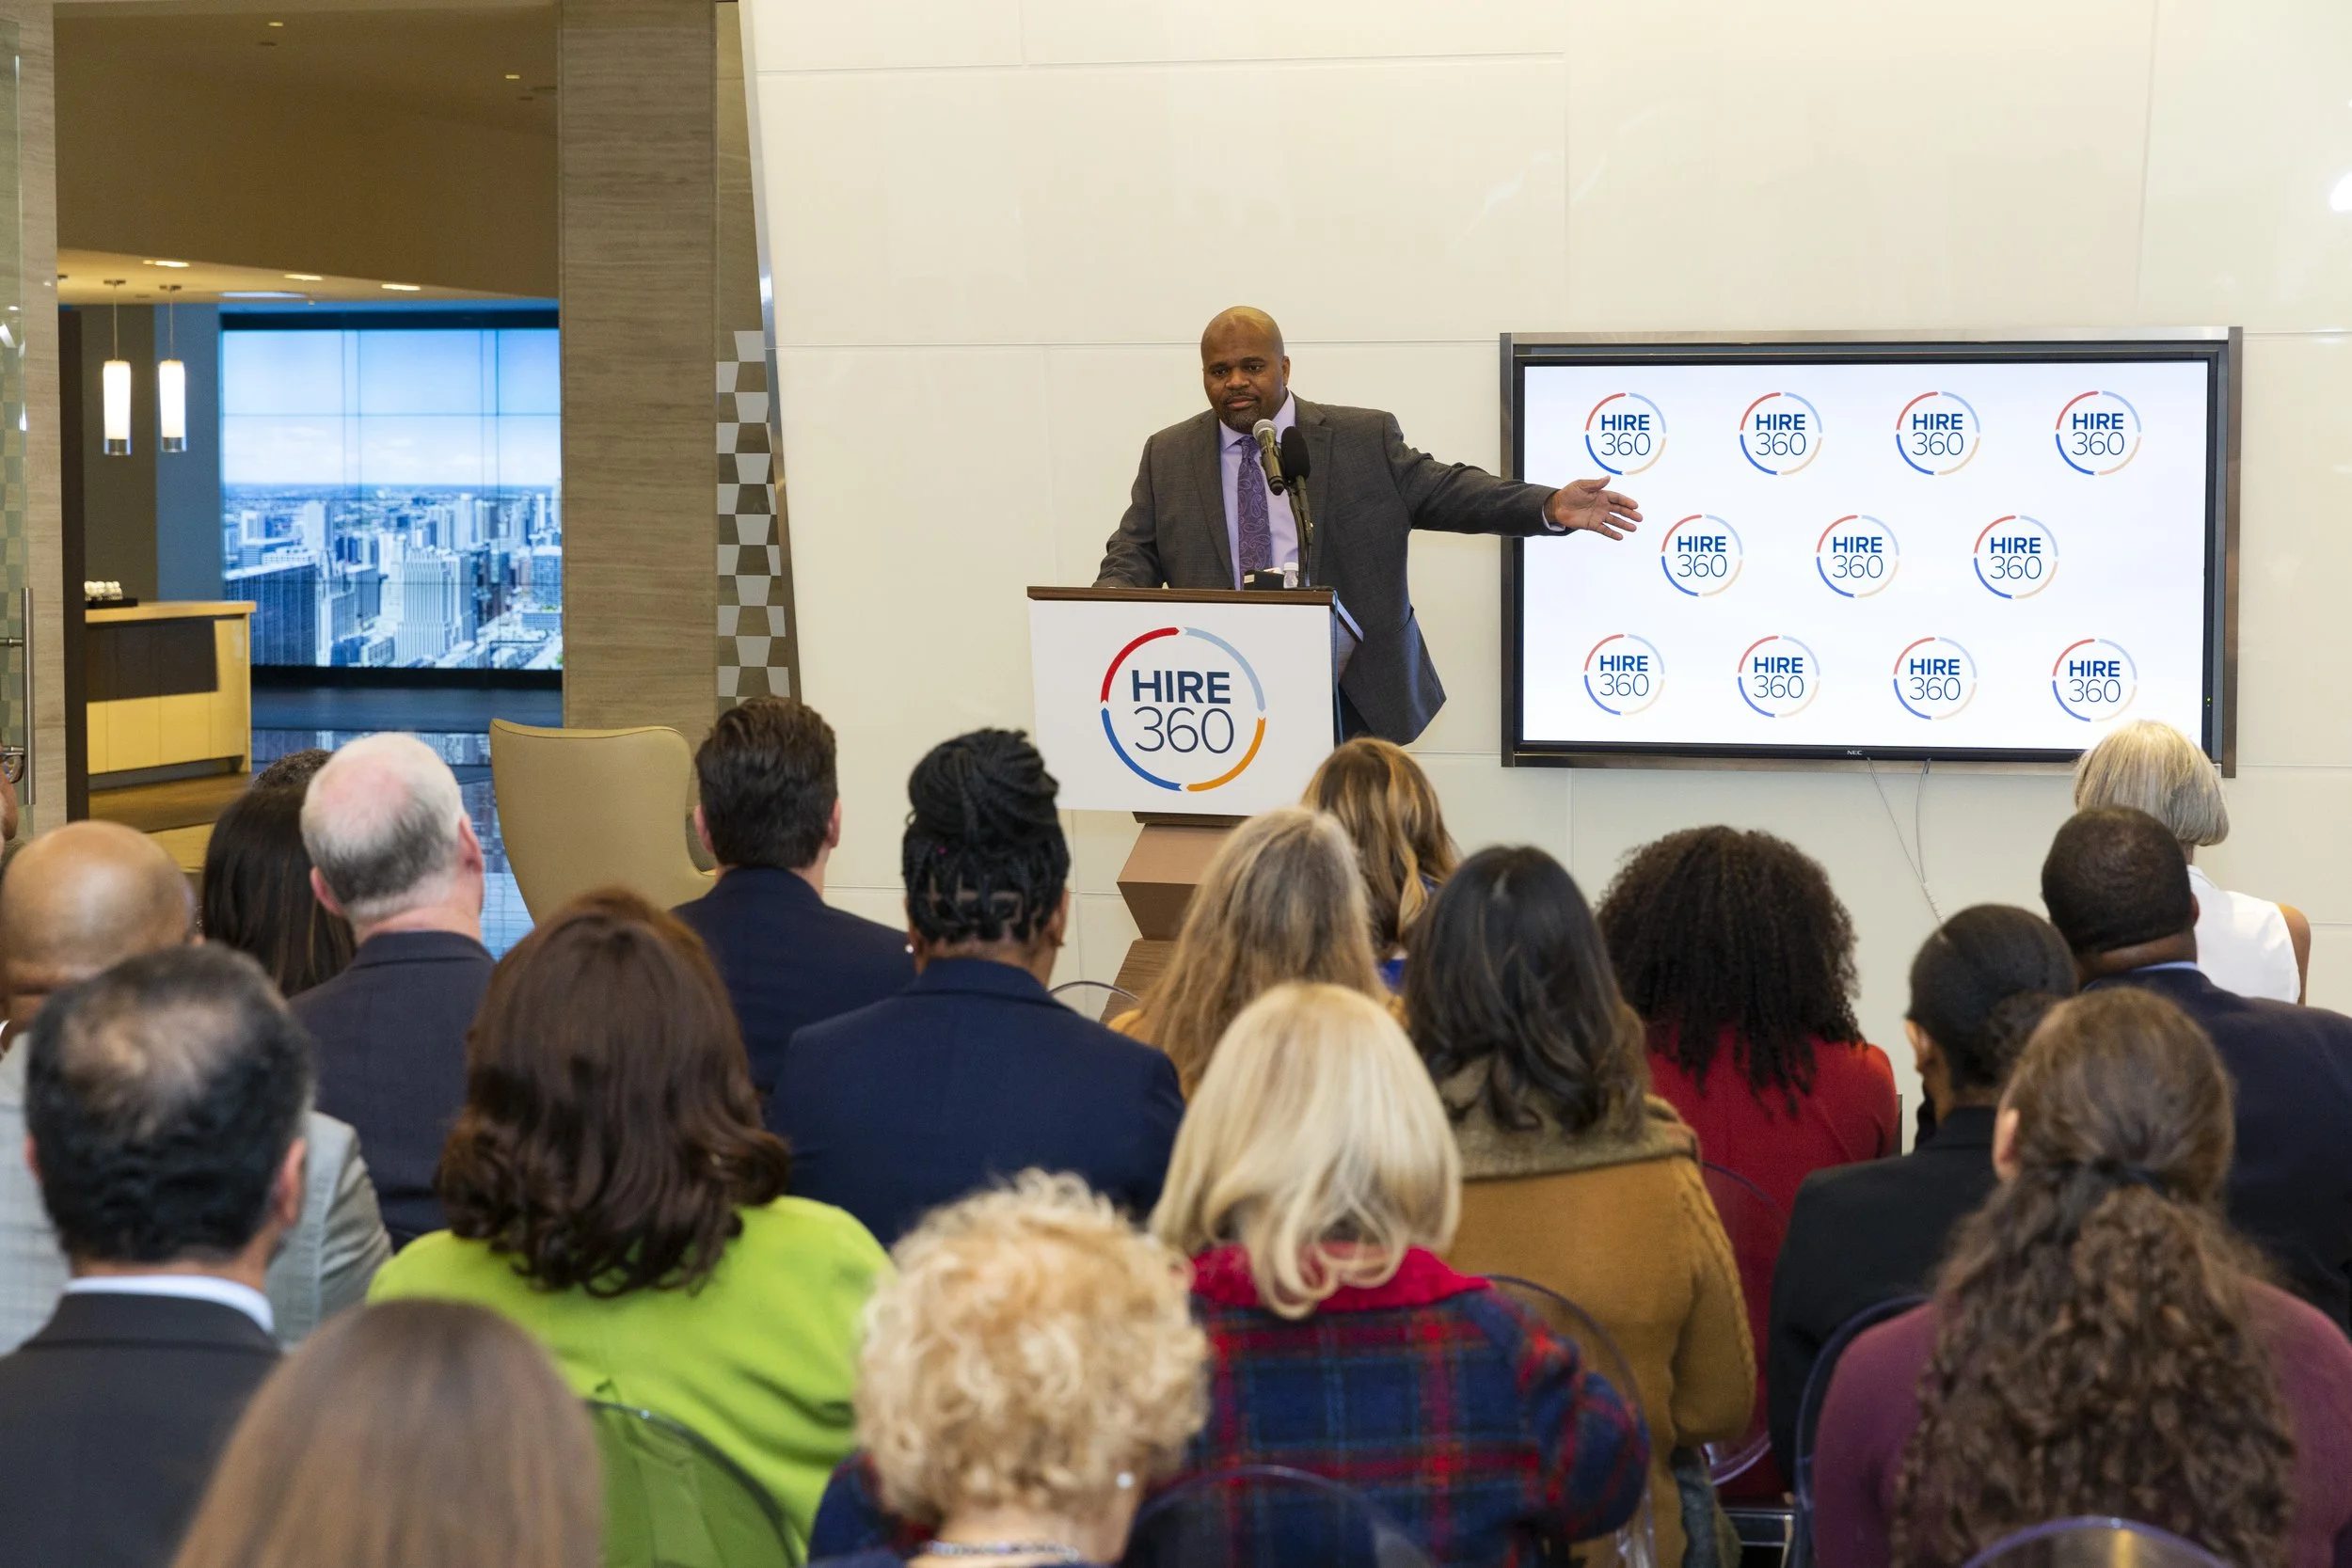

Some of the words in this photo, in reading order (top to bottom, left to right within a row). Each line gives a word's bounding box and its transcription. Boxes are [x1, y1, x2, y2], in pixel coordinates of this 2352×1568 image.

[1601, 414, 1649, 431] HIRE
[1756, 414, 1805, 430] HIRE
[1913, 414, 1963, 430] HIRE
[2073, 413, 2123, 430] HIRE
[1601, 433, 1650, 456] 360
[1756, 433, 1806, 456] 360
[1913, 432, 1963, 455] 360
[2073, 432, 2124, 455] 360
[1677, 536, 1726, 552] HIRE
[1833, 536, 1883, 553] HIRE
[1991, 537, 2041, 554] HIRE
[1677, 554, 1727, 578] 360
[1833, 555, 1883, 578] 360
[1991, 556, 2042, 579] 360
[1600, 656, 1648, 672] HIRE
[1755, 657, 1803, 673] HIRE
[1910, 658, 1960, 675] HIRE
[2070, 660, 2120, 677] HIRE
[1132, 670, 1231, 704] HIRE
[1600, 673, 1648, 697] 360
[1755, 675, 1804, 699] 360
[1910, 677, 1961, 701] 360
[2070, 679, 2121, 703] 360
[1134, 706, 1234, 754] 360
